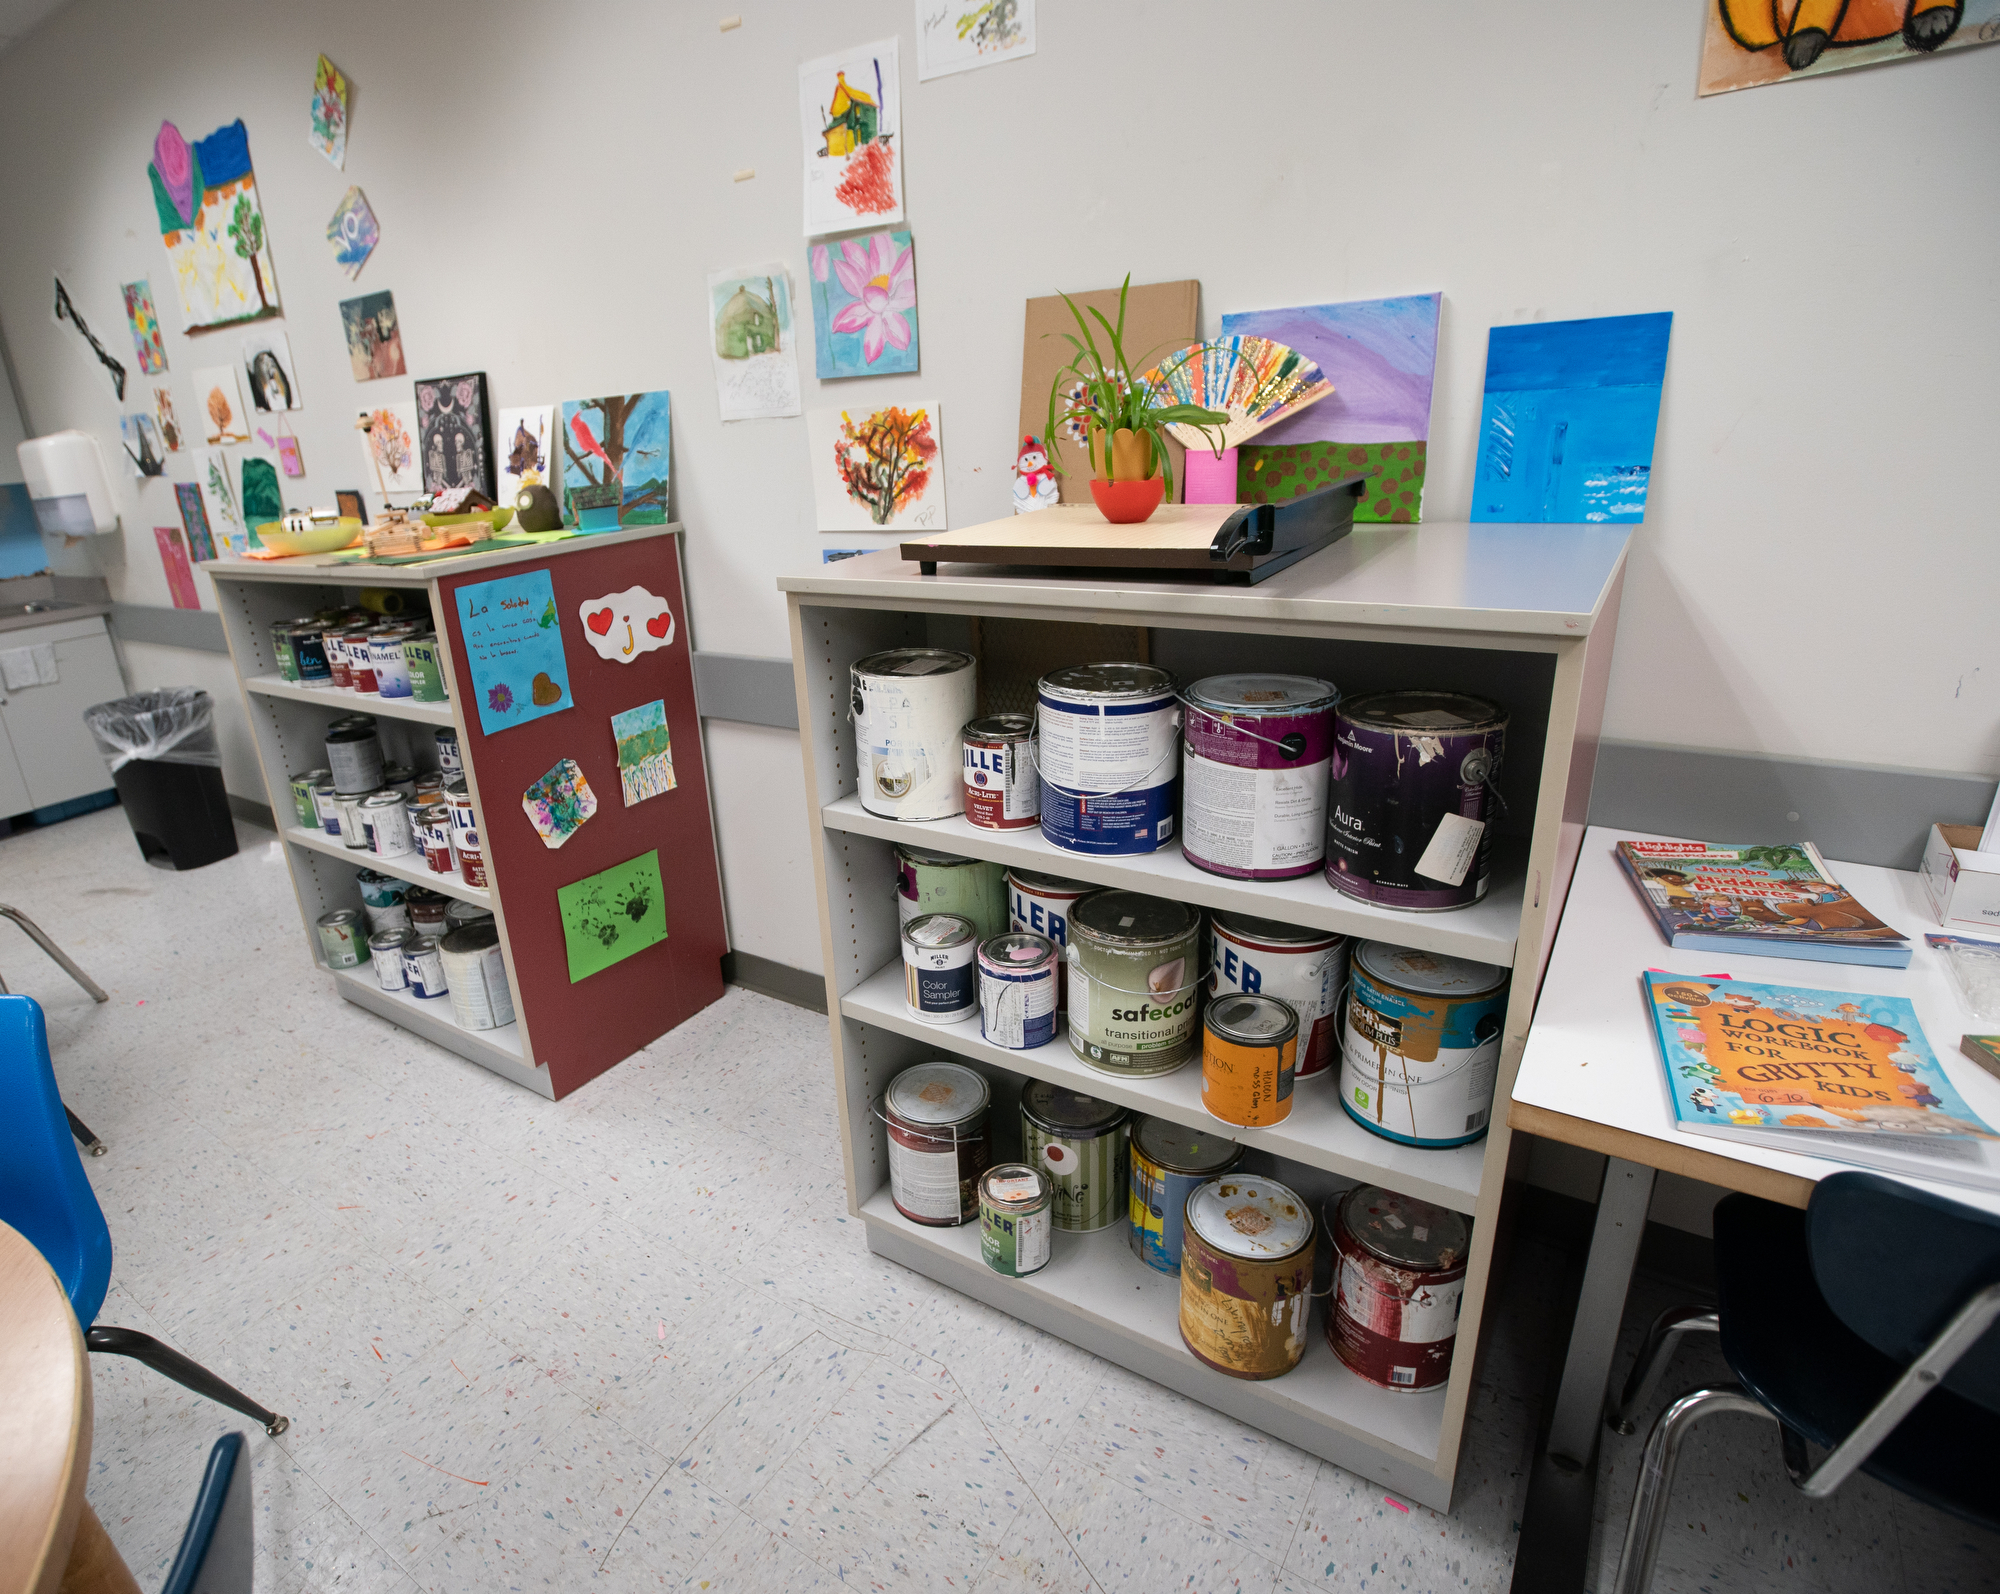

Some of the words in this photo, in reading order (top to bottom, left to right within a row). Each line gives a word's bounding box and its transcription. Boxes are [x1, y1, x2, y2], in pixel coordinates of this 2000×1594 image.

[469, 598, 489, 618] La
[300, 651, 322, 666] ben
[1354, 742, 1373, 753] Moore
[1334, 804, 1363, 831] Aura
[1631, 841, 1705, 852] Highlights
[1694, 865, 1770, 877] Jumbo
[1694, 874, 1788, 890] Hidden
[1692, 882, 1800, 900] Pictures
[922, 980, 948, 989] Color
[1366, 986, 1381, 998] SATIN
[923, 989, 961, 1000] Sampler
[1667, 992, 1707, 1004] activities
[1111, 989, 1197, 1022] safecoat
[1105, 1025, 1175, 1041] transitional
[1375, 1031, 1396, 1046] PLUS
[1717, 1013, 1863, 1049] LOGIC
[1108, 1041, 1133, 1050] purpose
[1141, 1040, 1167, 1050] problem
[1719, 1028, 1872, 1061] WORKBOOK
[1724, 1041, 1788, 1061] FOR
[1384, 1067, 1396, 1077] IN
[1736, 1061, 1882, 1083] GRITTY
[1361, 1080, 1378, 1093] ODOR
[1813, 1080, 1892, 1102] KIDS
[1210, 1312, 1229, 1326] ONE
